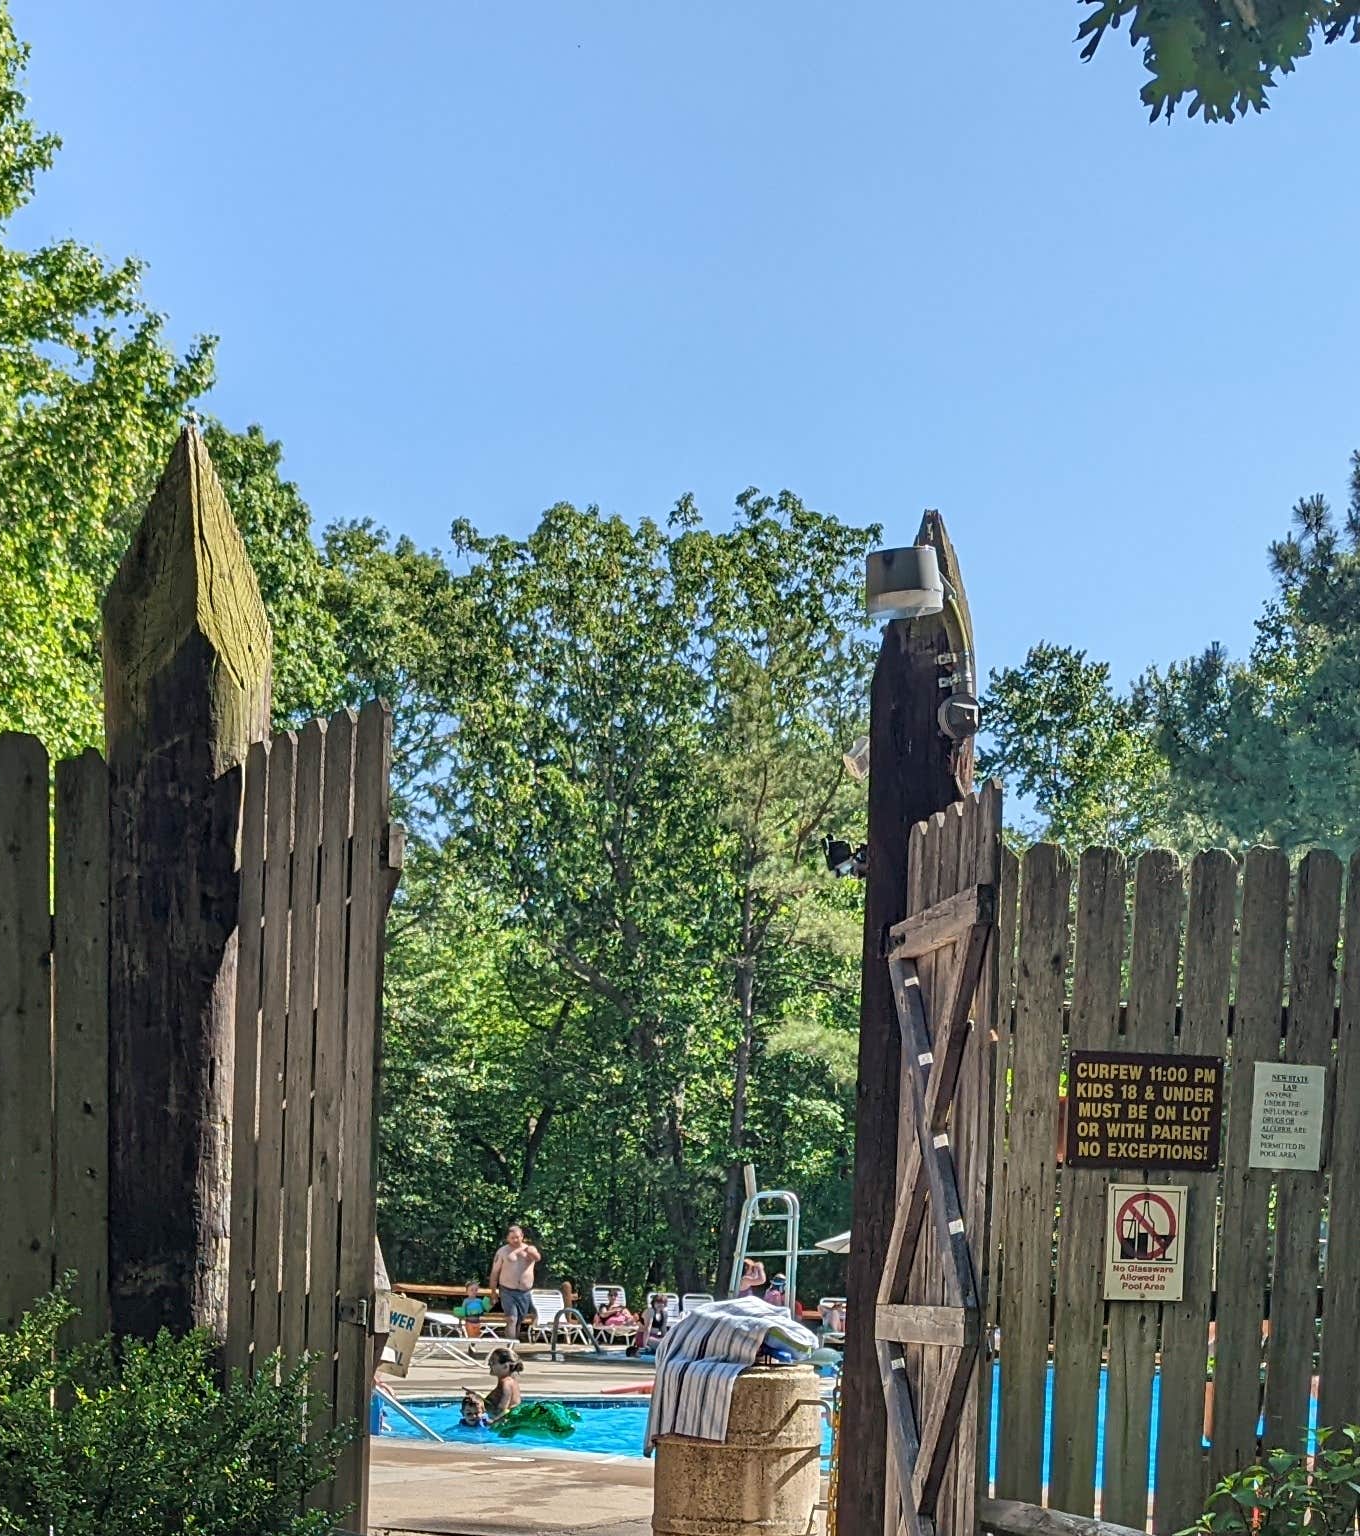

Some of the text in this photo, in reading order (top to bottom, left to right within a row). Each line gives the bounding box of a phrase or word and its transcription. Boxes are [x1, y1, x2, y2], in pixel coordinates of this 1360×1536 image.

[1076, 1062, 1216, 1084] CURFEW 11:00 PM
[1272, 1074, 1287, 1082] NEW
[1076, 1082, 1214, 1103] KIDS 18 & UNDER
[1078, 1102, 1211, 1122] MUST BE ON LOT
[1077, 1122, 1211, 1141] OR WITH PARENT
[1078, 1141, 1208, 1161] NO EXCEPTIONS!
[1260, 1142, 1297, 1150] PERMITTED
[1113, 1264, 1174, 1274] No Glassware
[1120, 1273, 1155, 1282] Allowed
[1122, 1281, 1165, 1291] Pool Area
